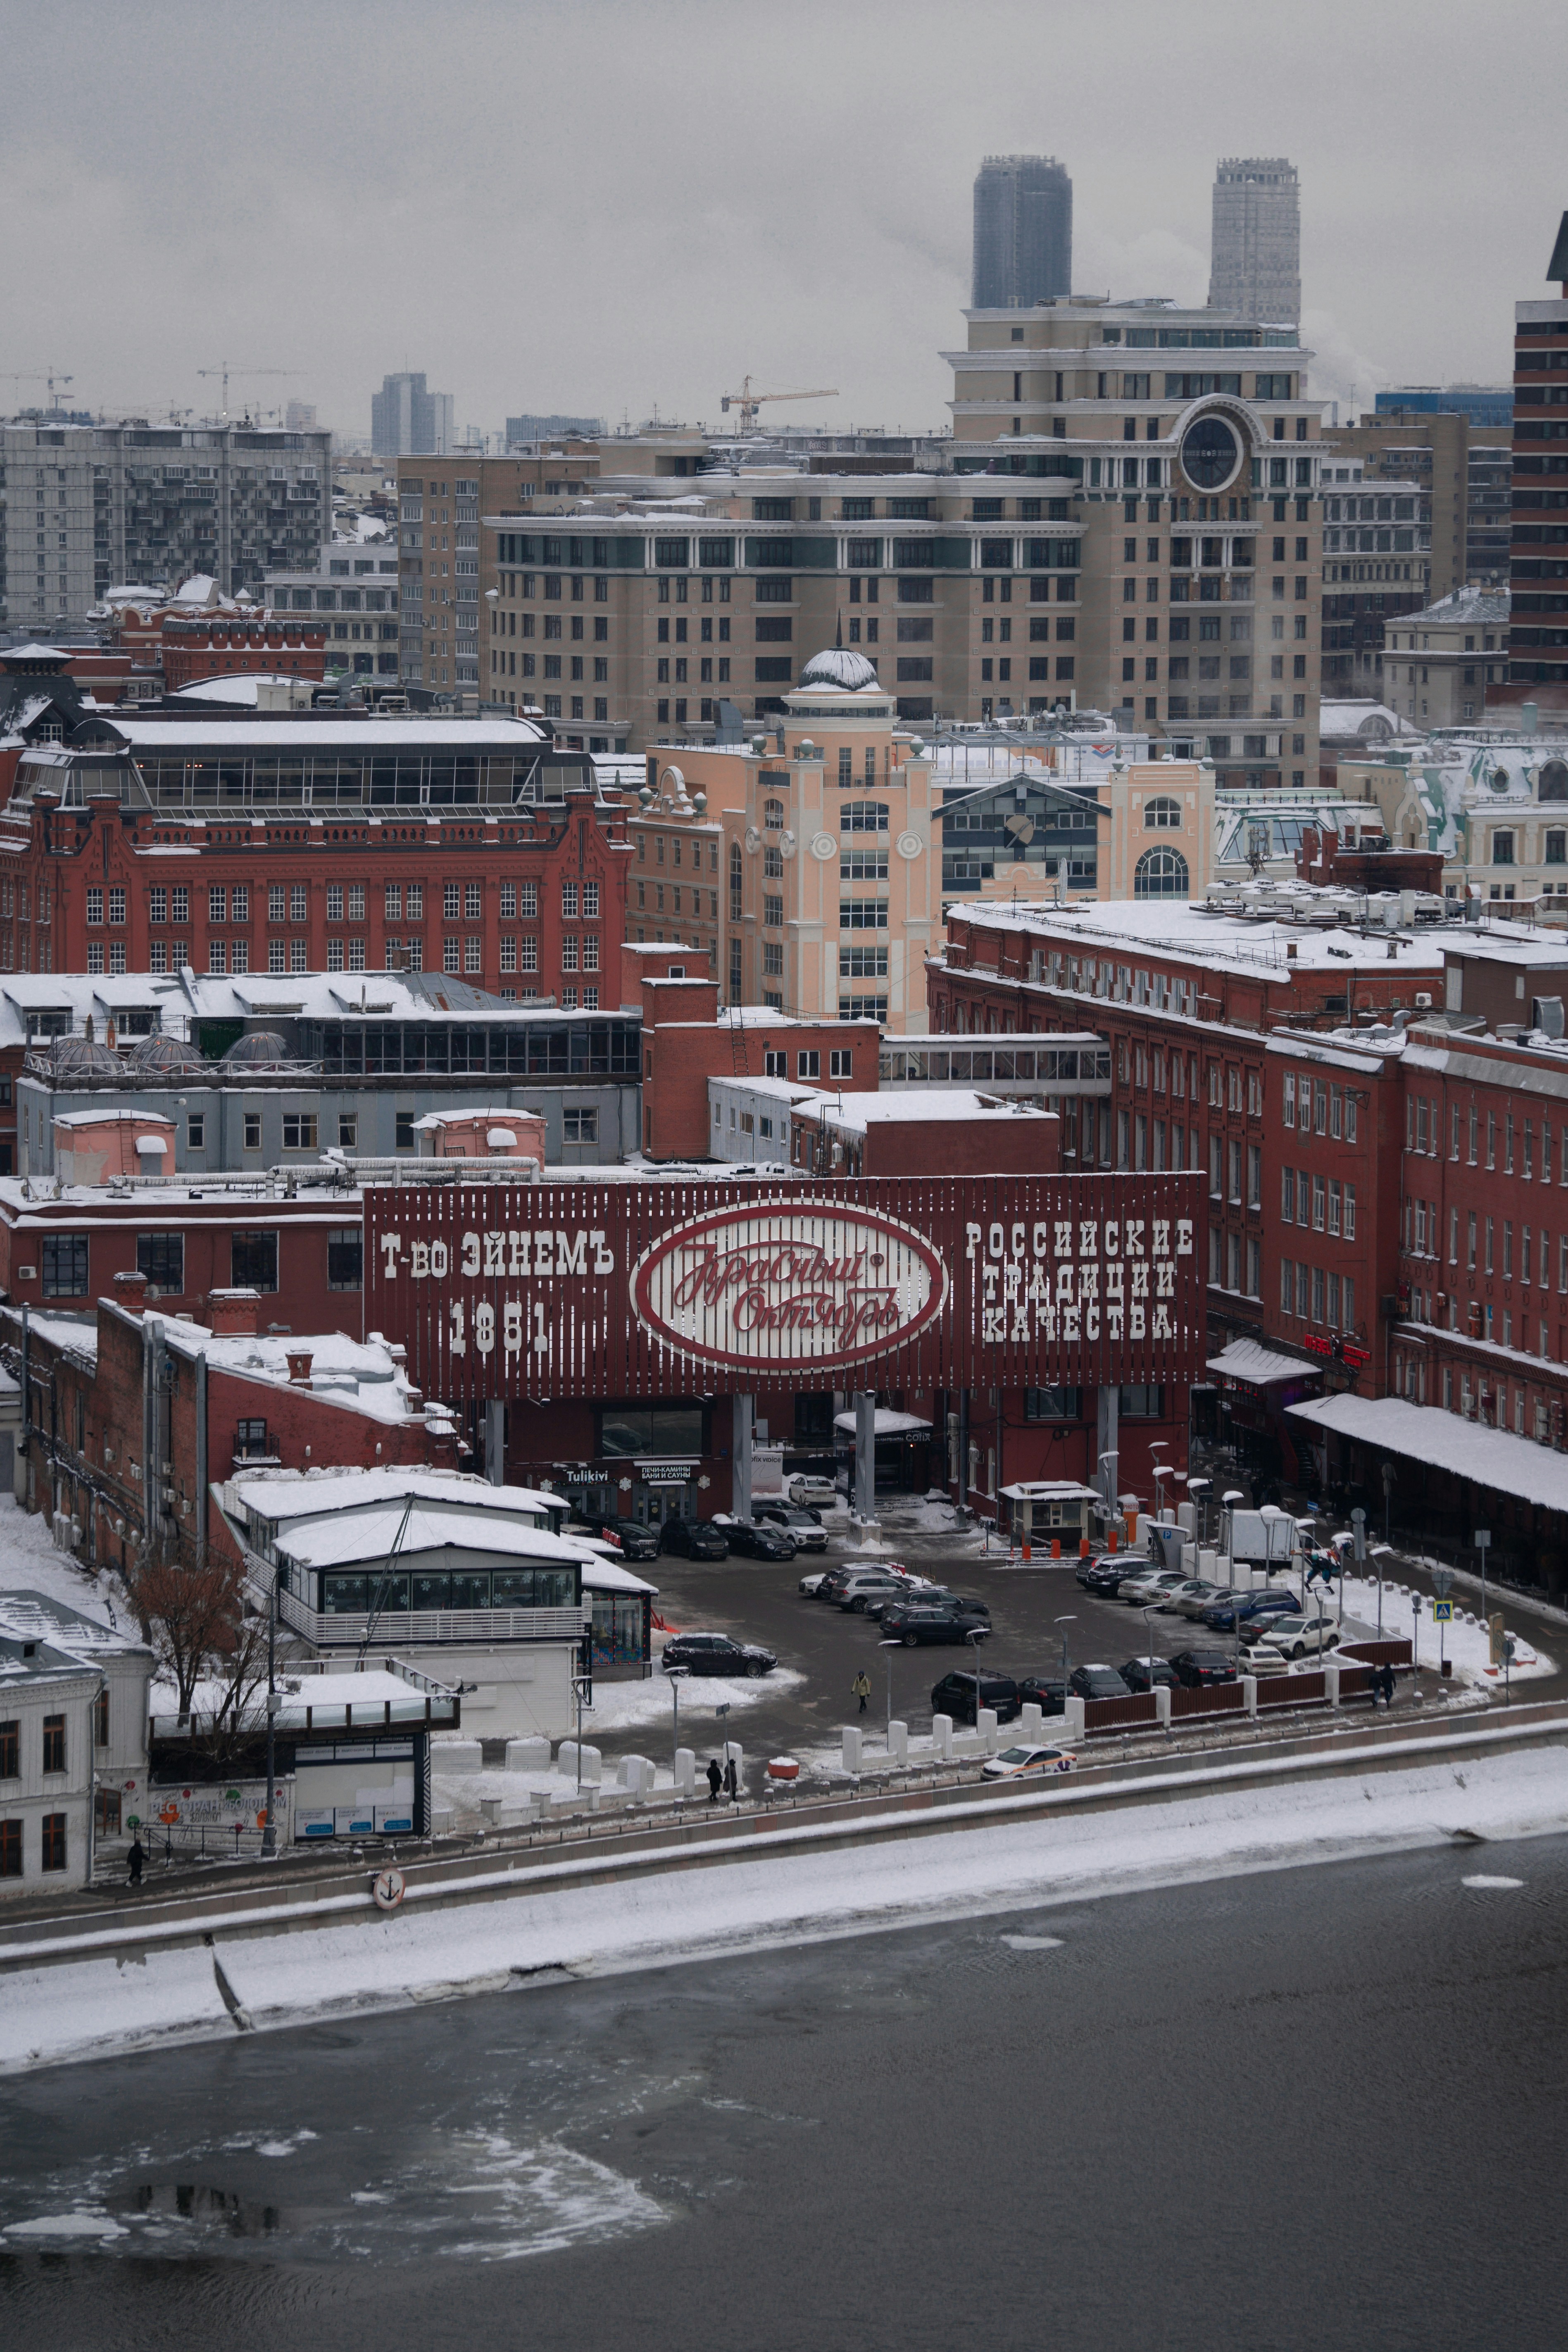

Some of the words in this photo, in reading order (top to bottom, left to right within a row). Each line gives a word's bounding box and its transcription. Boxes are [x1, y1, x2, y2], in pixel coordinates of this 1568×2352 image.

[462, 1229, 614, 1276] ЭЙНЕМЪ
[966, 1219, 1193, 1258] РОССИЙСКИЕ
[674, 1240, 868, 1306] Красный
[984, 1262, 1174, 1303] ТРАДИЦИИ
[452, 1302, 547, 1353] 1851
[733, 1286, 904, 1349] Октябрь
[985, 1304, 1172, 1342] КАЧЕСТВА
[906, 1432, 930, 1442] cofix
[566, 1470, 608, 1482] Tulikivi
[150, 1800, 219, 1814] РЕСТОРАН
